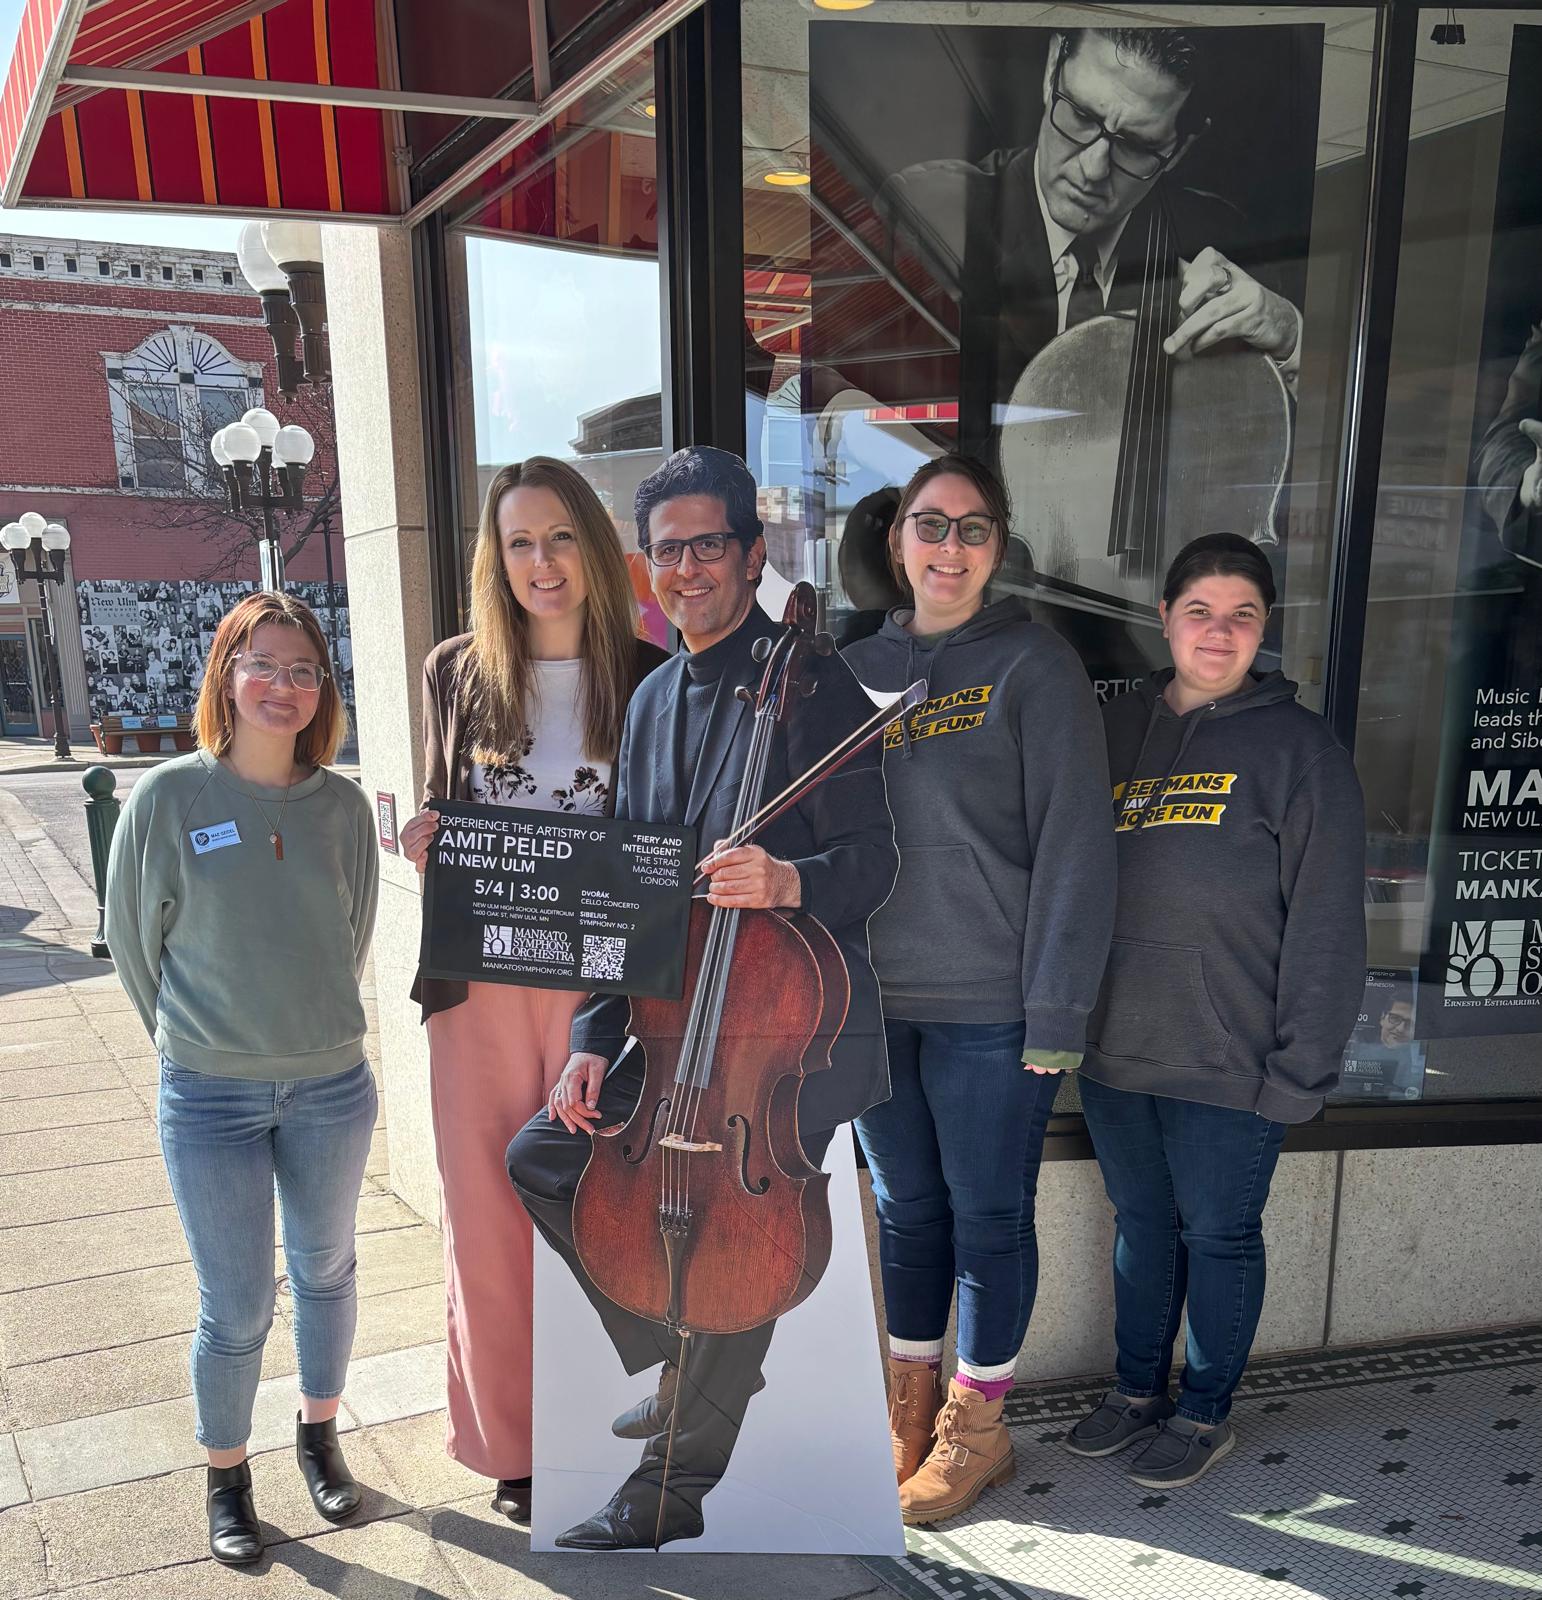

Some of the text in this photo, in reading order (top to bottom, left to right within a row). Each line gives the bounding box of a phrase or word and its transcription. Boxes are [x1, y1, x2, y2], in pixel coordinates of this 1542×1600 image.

[1476, 688, 1530, 705] Music
[1474, 710, 1522, 727] leads
[1471, 731, 1542, 749] and Sib
[1169, 806, 1214, 820] FUN
[1463, 811, 1542, 828] NEW UL
[441, 815, 606, 842] EXPERIENCE THE ARTISTRY OF
[439, 829, 573, 859] AMIT PELED
[633, 834, 682, 846] "FIERY AND
[622, 843, 681, 857] INTELLIGENT"
[439, 851, 535, 873] IN NEW ULM
[635, 855, 680, 867] THE STRAD
[632, 865, 679, 877] MAGAZINE,
[640, 876, 679, 887] LONDON
[1455, 878, 1542, 899] MANK
[474, 879, 504, 896] 5/4
[520, 884, 559, 902] 3:00
[515, 906, 539, 914] SCHOOL
[581, 898, 640, 909] CELLO CONCERTO
[580, 911, 608, 919] SIBELIUS
[580, 919, 616, 928] SYMPHONY
[514, 927, 568, 942] MANKATO
[512, 938, 572, 951] SYMPHONY
[512, 947, 575, 962] ORCHESTRA
[482, 962, 573, 976] MANKATOSYMPHONY.ORG
[1444, 998, 1540, 1007] ERNESTO ESTIGARRIBIA
